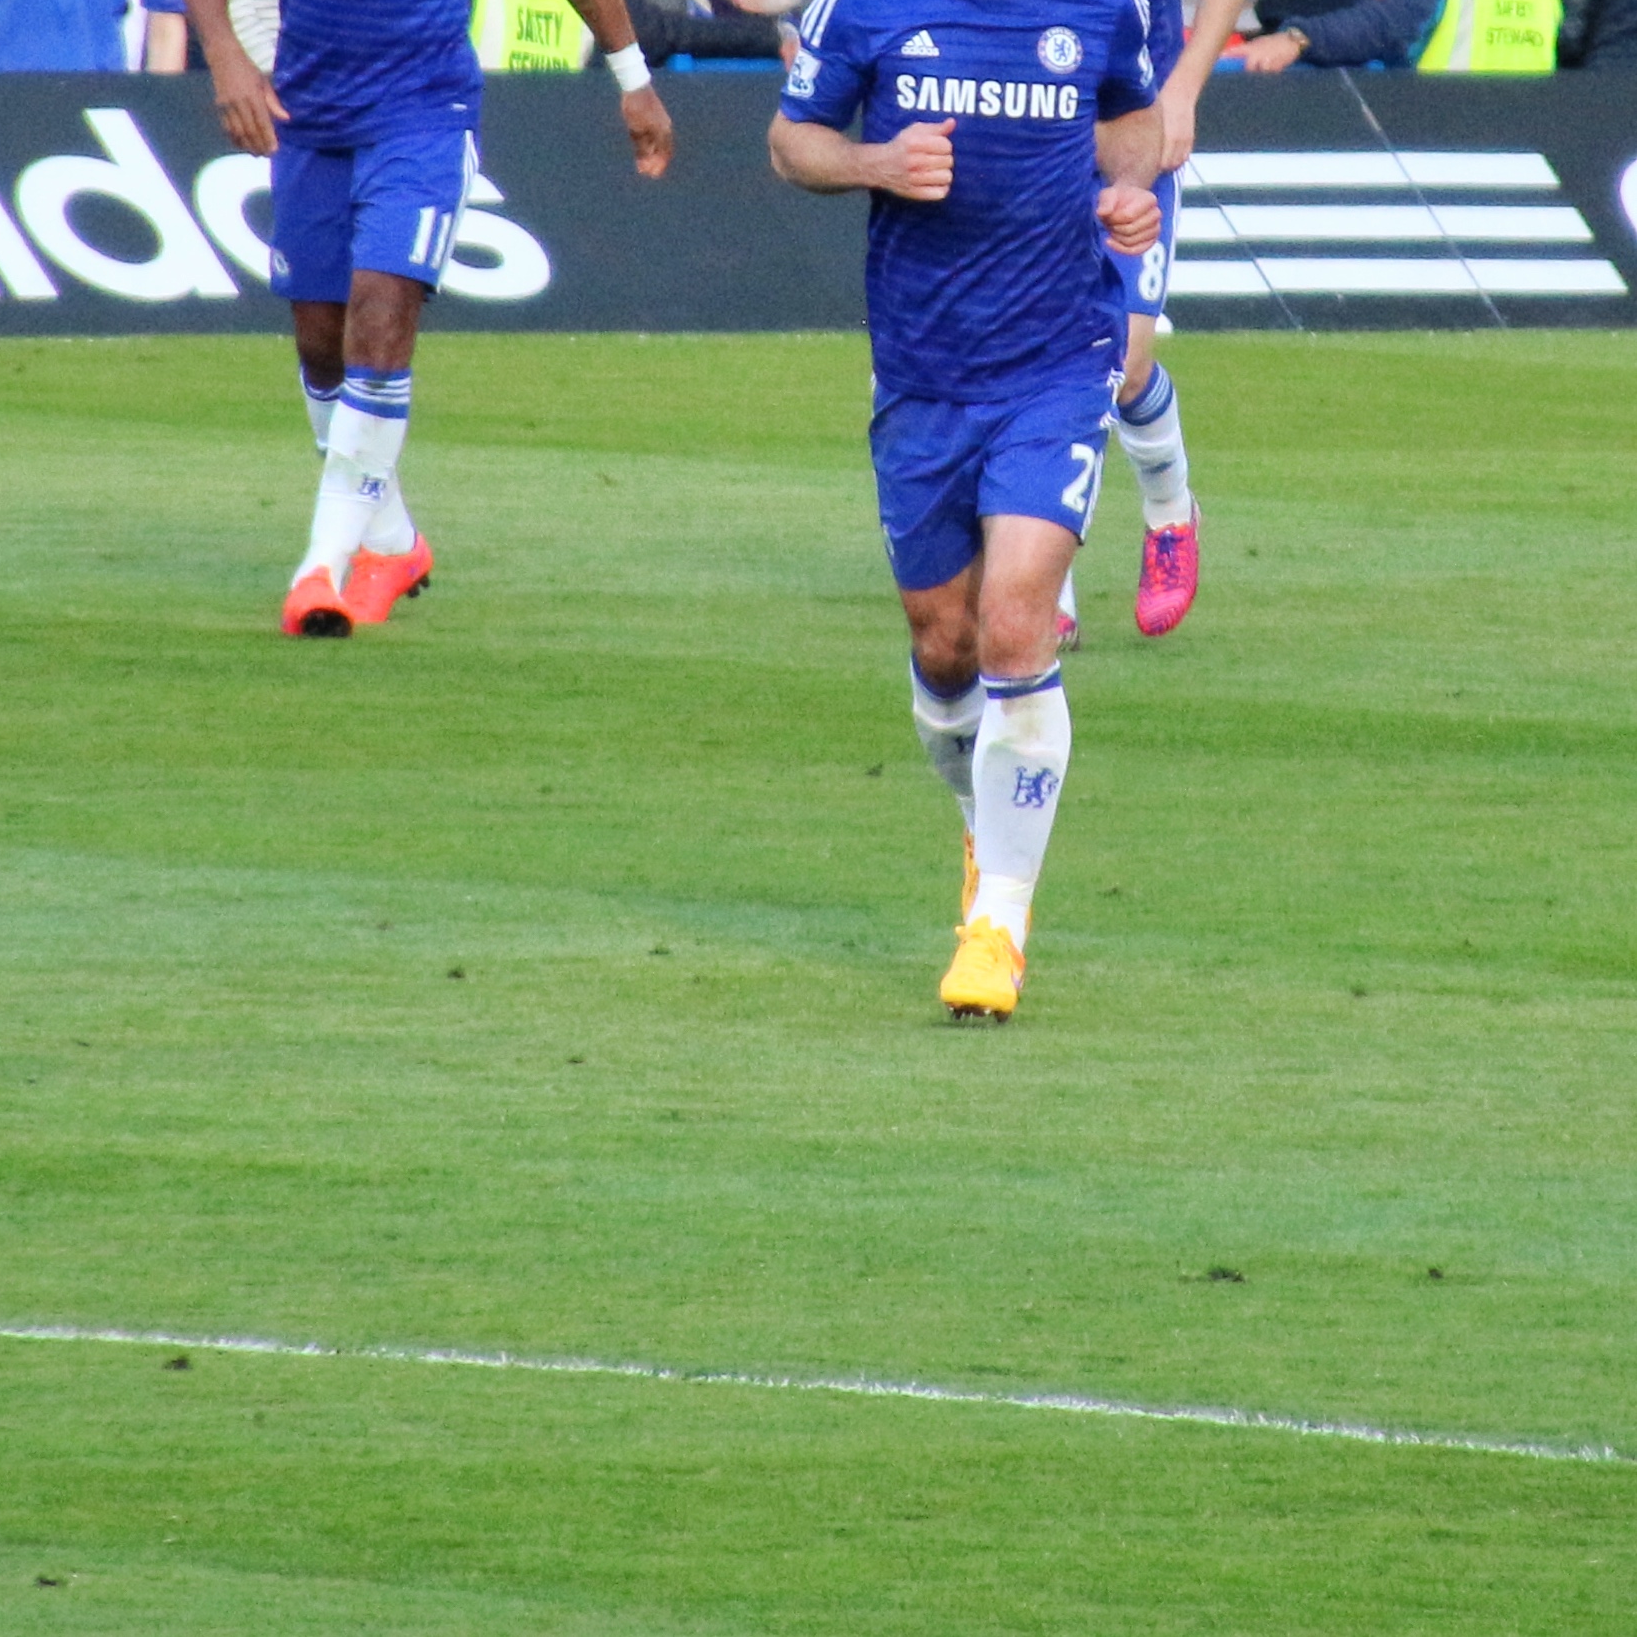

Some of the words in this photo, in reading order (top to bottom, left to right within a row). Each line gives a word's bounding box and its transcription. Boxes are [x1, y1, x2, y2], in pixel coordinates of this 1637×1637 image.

[896, 74, 1079, 121] SAMSUNG
[408, 205, 452, 272] 11
[1138, 240, 1167, 301] 8
[1061, 443, 1097, 513] 2
